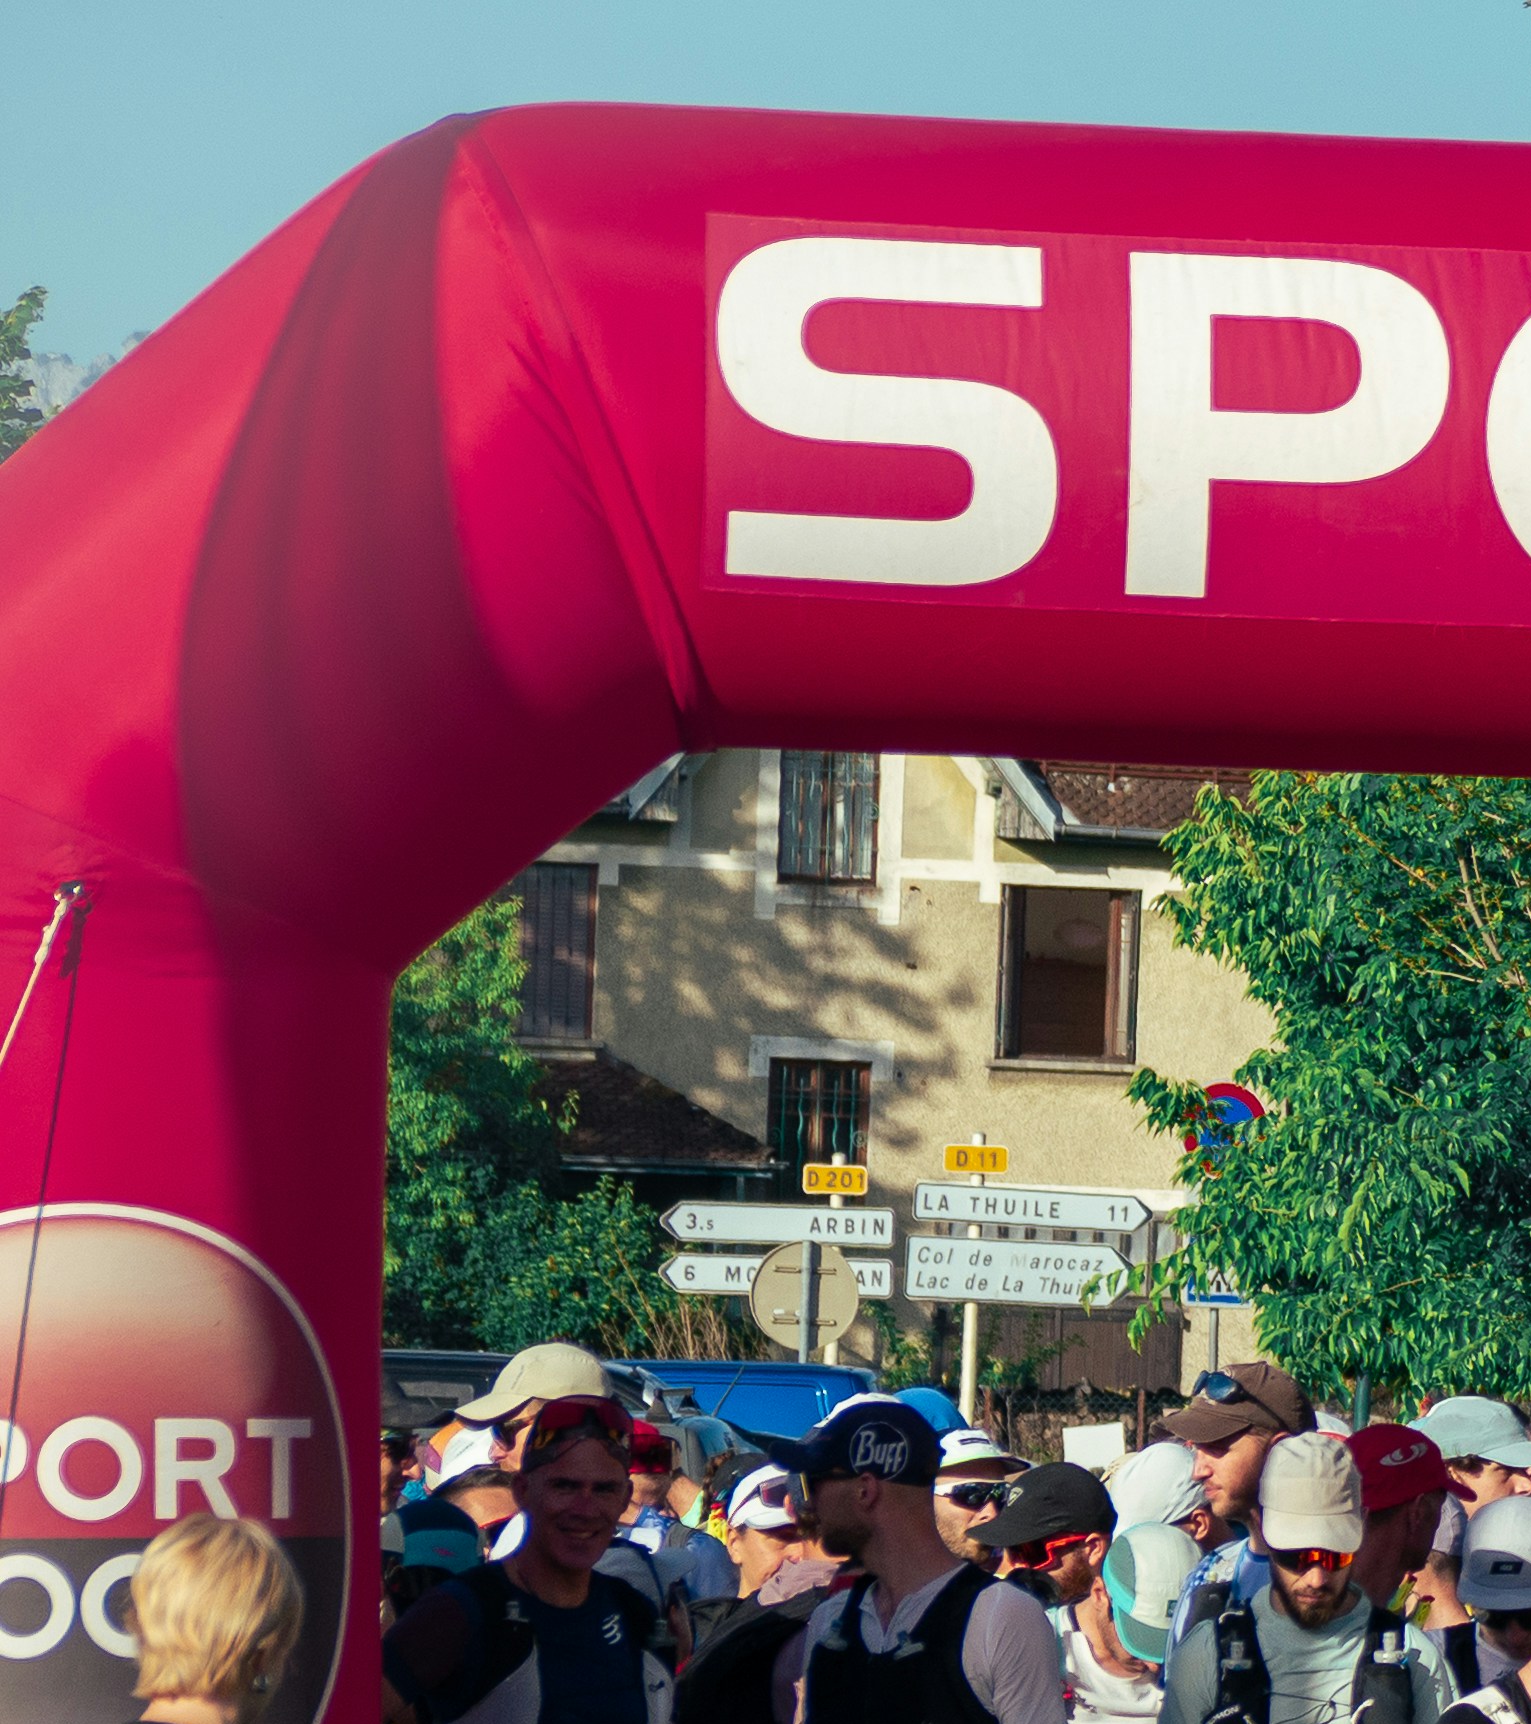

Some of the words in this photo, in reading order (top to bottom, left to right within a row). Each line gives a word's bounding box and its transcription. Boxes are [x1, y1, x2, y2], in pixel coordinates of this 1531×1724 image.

[957, 1151, 968, 1167] D
[977, 1151, 997, 1167] 11
[807, 1174, 820, 1187] D
[826, 1171, 865, 1188] 201
[923, 1193, 949, 1212] LA
[970, 1197, 1061, 1219] THUILE
[1107, 1205, 1129, 1222] 11
[809, 1216, 885, 1235] ARBIN
[917, 1246, 954, 1265] Col
[968, 1249, 993, 1267] de
[1010, 1253, 1104, 1273] Marocaz
[684, 1264, 696, 1281] 6
[915, 1271, 950, 1290] Lac
[964, 1274, 988, 1291] de
[1002, 1275, 1024, 1293] La
[1039, 1276, 1101, 1297] Thui
